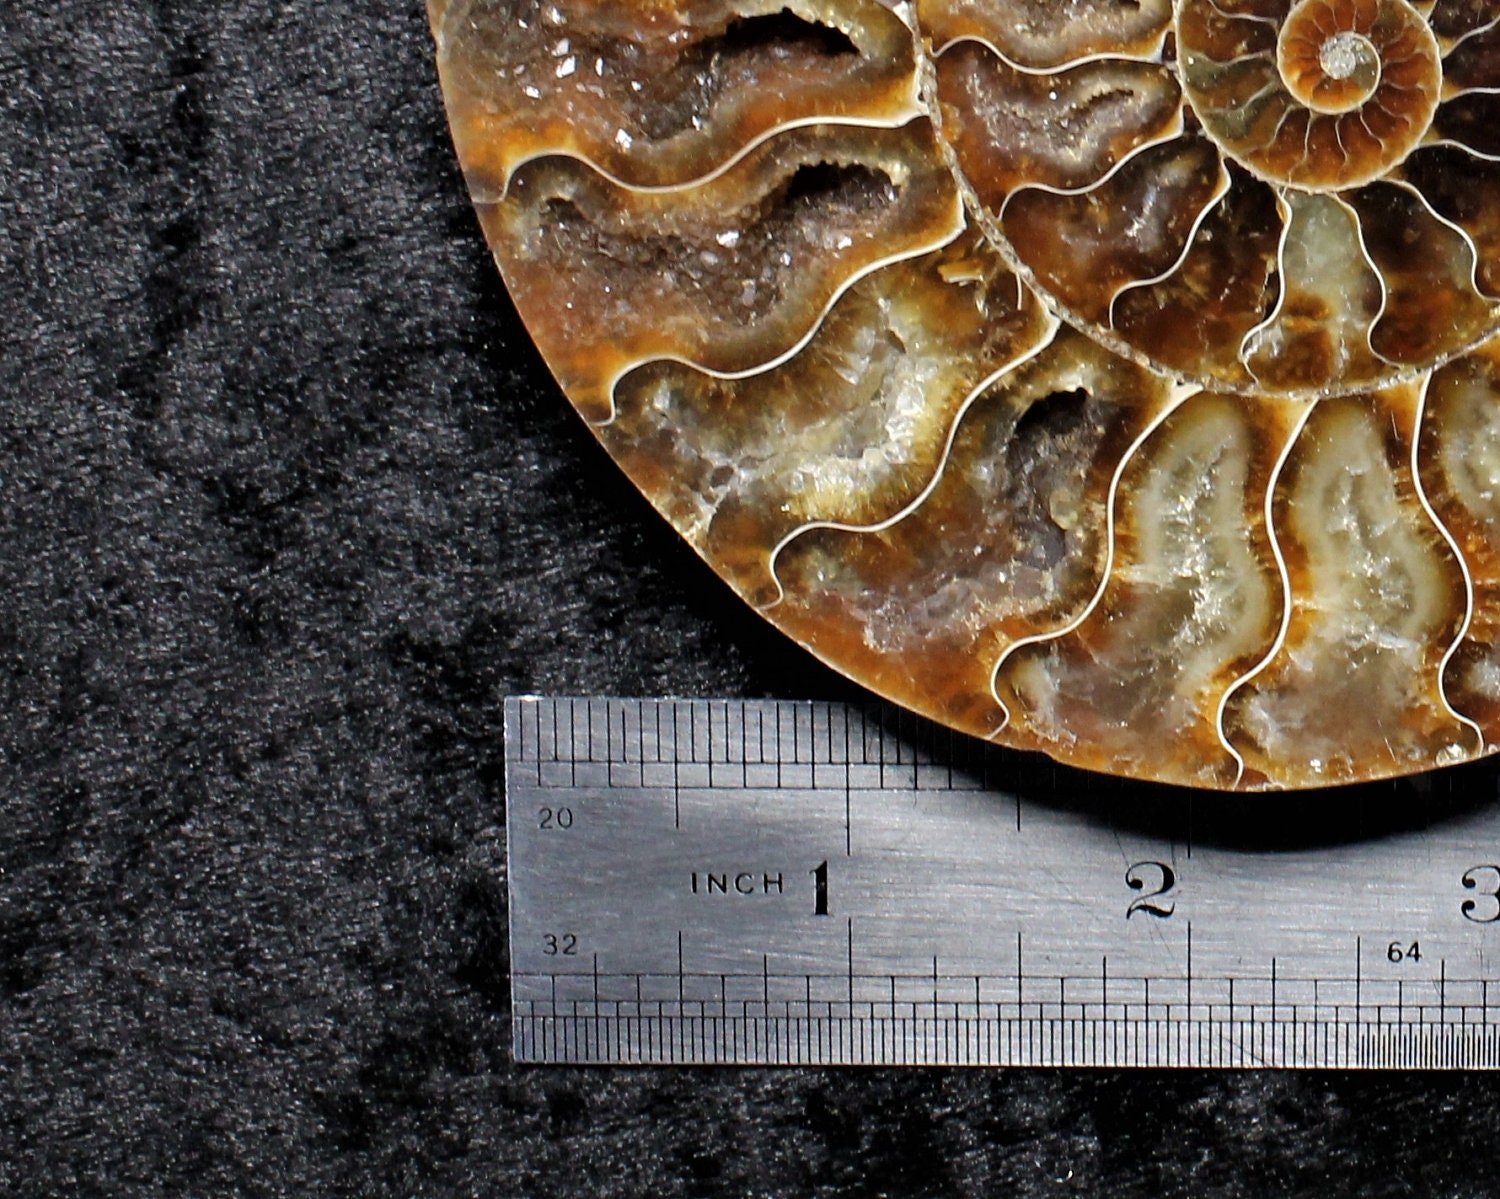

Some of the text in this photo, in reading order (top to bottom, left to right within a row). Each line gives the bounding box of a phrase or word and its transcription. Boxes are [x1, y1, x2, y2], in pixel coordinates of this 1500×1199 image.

[539, 807, 574, 830] 20
[690, 872, 784, 894] INCH
[811, 860, 829, 916] 1
[1125, 861, 1176, 920] 2
[543, 934, 578, 956] 32
[1387, 942, 1422, 963] 64
